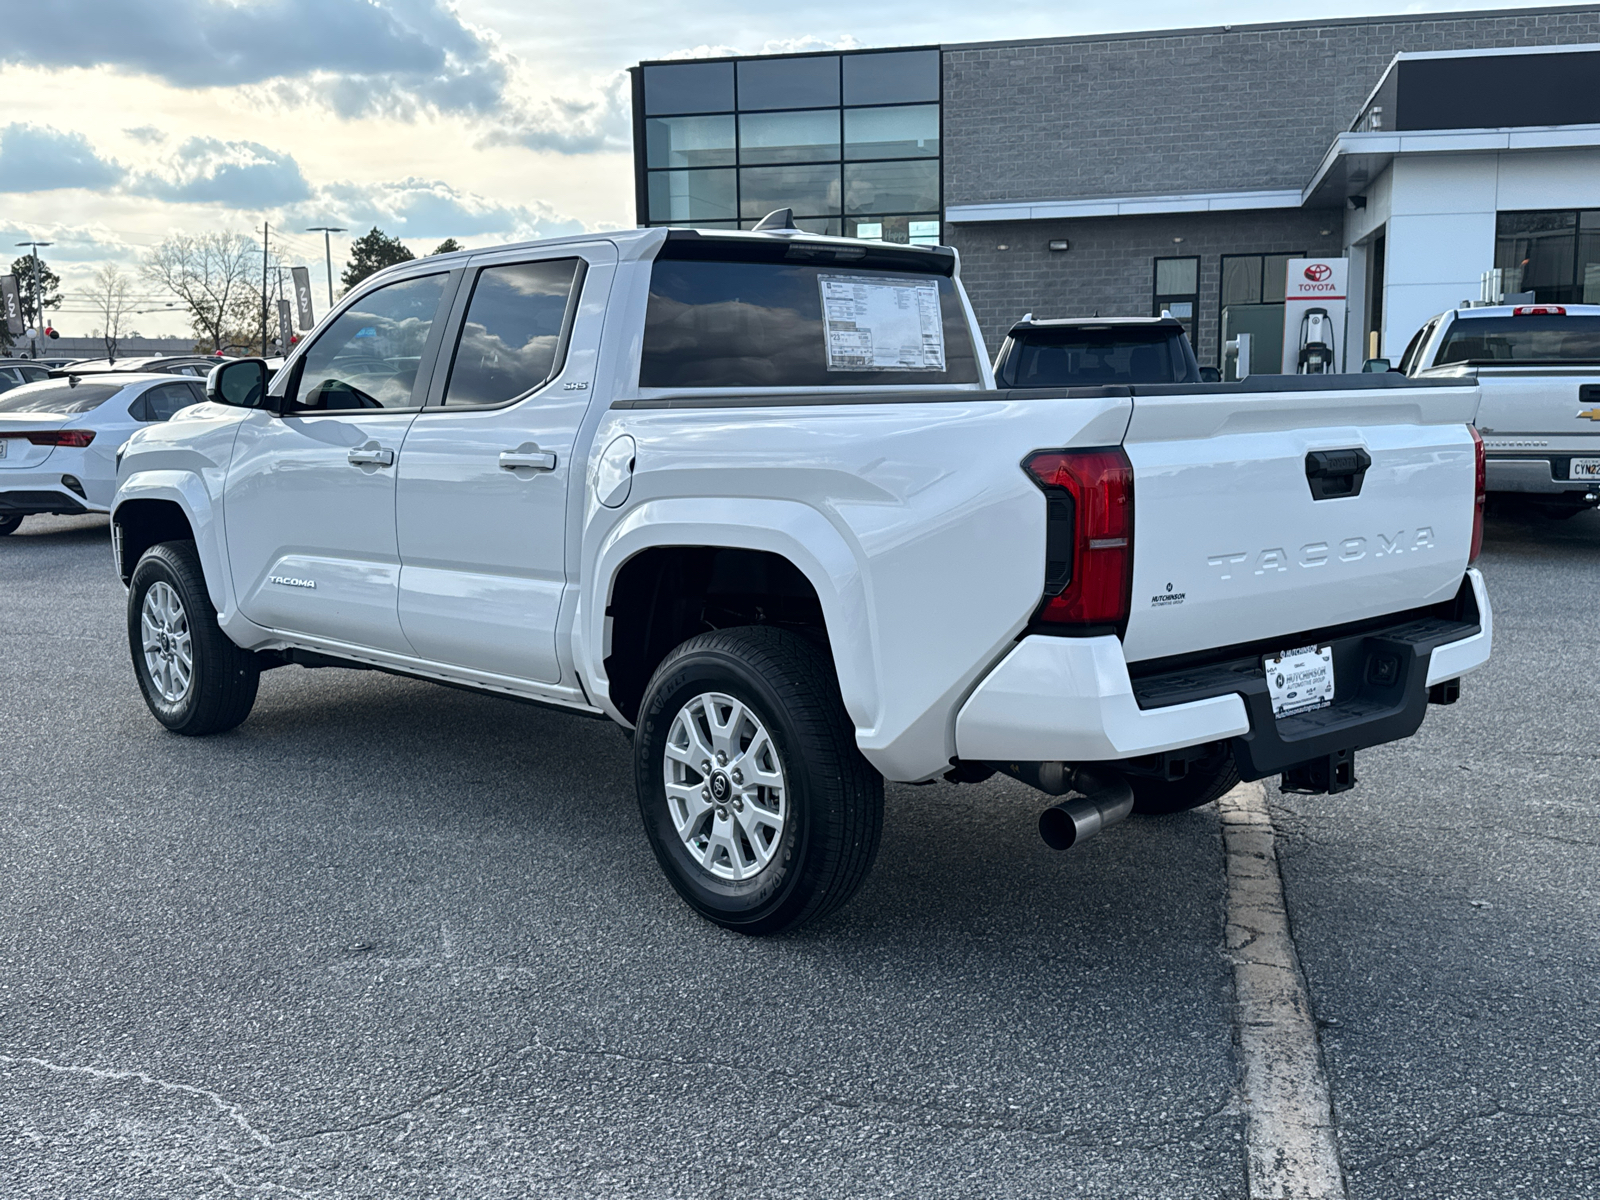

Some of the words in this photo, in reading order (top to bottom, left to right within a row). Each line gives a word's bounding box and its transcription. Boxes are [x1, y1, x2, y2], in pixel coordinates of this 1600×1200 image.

[1298, 283, 1336, 291] TOYOTA
[564, 381, 588, 391] SR5
[1328, 457, 1356, 468] TOYOTA
[1207, 526, 1435, 580] TACOMA
[269, 575, 317, 589] TACOMA
[1151, 593, 1186, 602] HUTCHINSON
[1286, 644, 1318, 657] HUTCHINSON
[1286, 668, 1327, 684] HUTCHINSON
[1287, 680, 1312, 690] AUTOMOTIVE
[1312, 676, 1325, 685] GROUP
